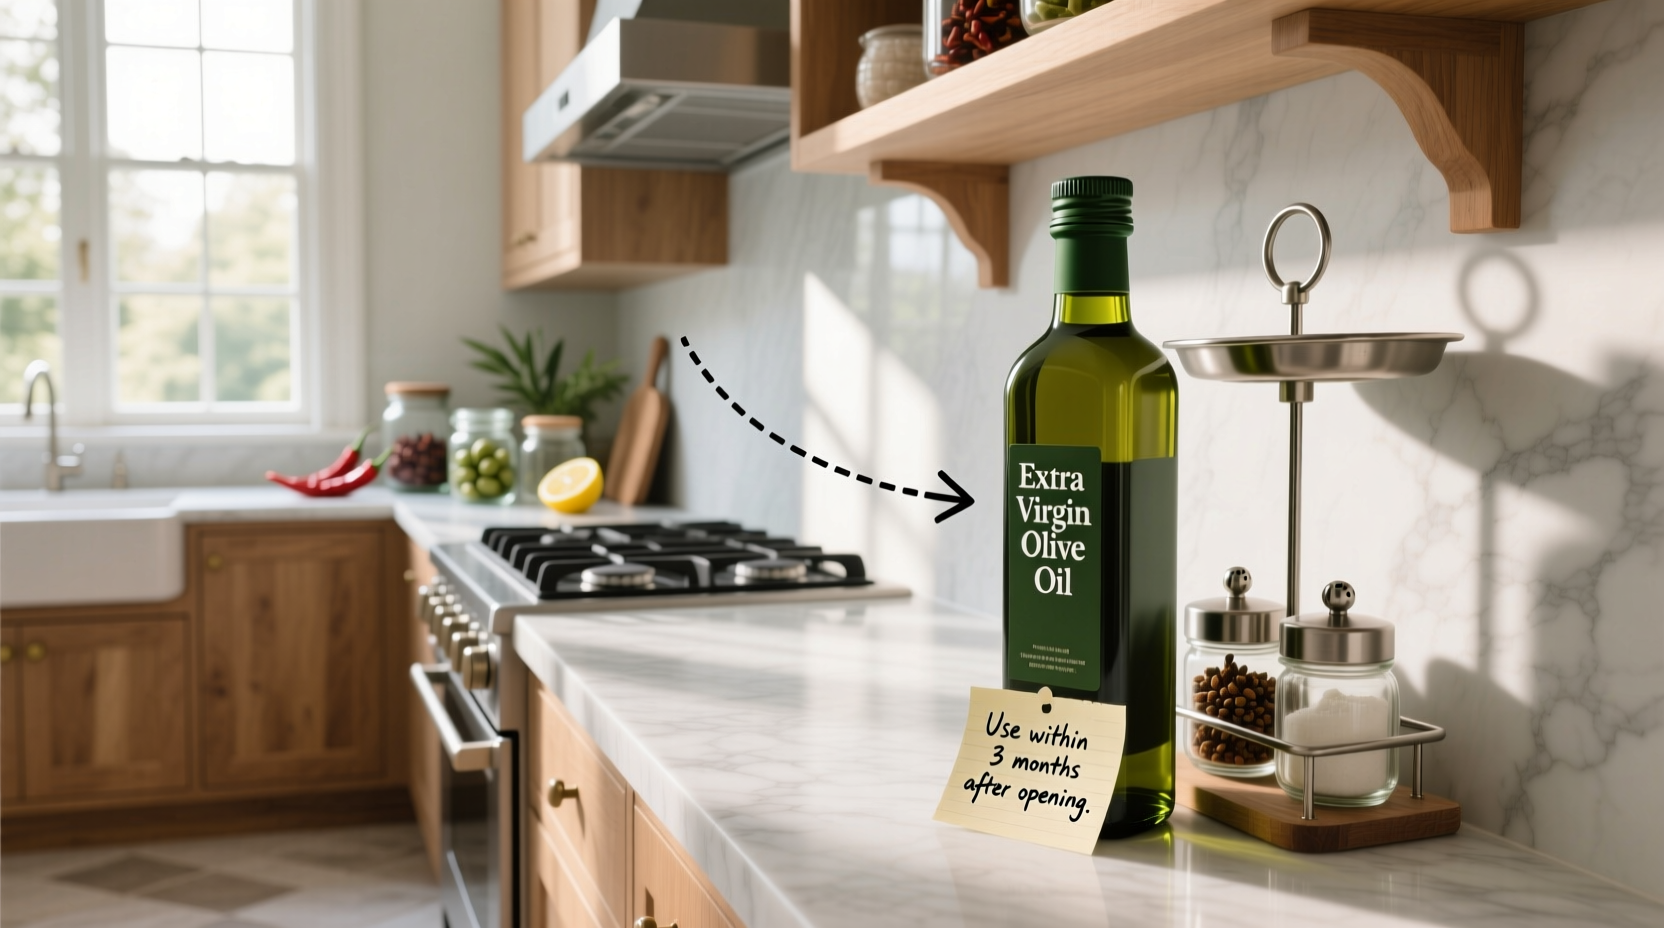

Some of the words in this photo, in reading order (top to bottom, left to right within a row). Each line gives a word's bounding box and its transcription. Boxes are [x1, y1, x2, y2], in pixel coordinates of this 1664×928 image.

[1018, 462, 1085, 492] Extra
[1015, 495, 1092, 533] Virgin
[1020, 529, 1086, 562] Olive
[1034, 565, 1073, 596] Oil
[986, 711, 1021, 740] Use
[1029, 723, 1088, 751] within
[989, 745, 1005, 767] 3
[1012, 755, 1081, 779] months
[963, 771, 1012, 804] after
[1017, 789, 1091, 823] opening.
